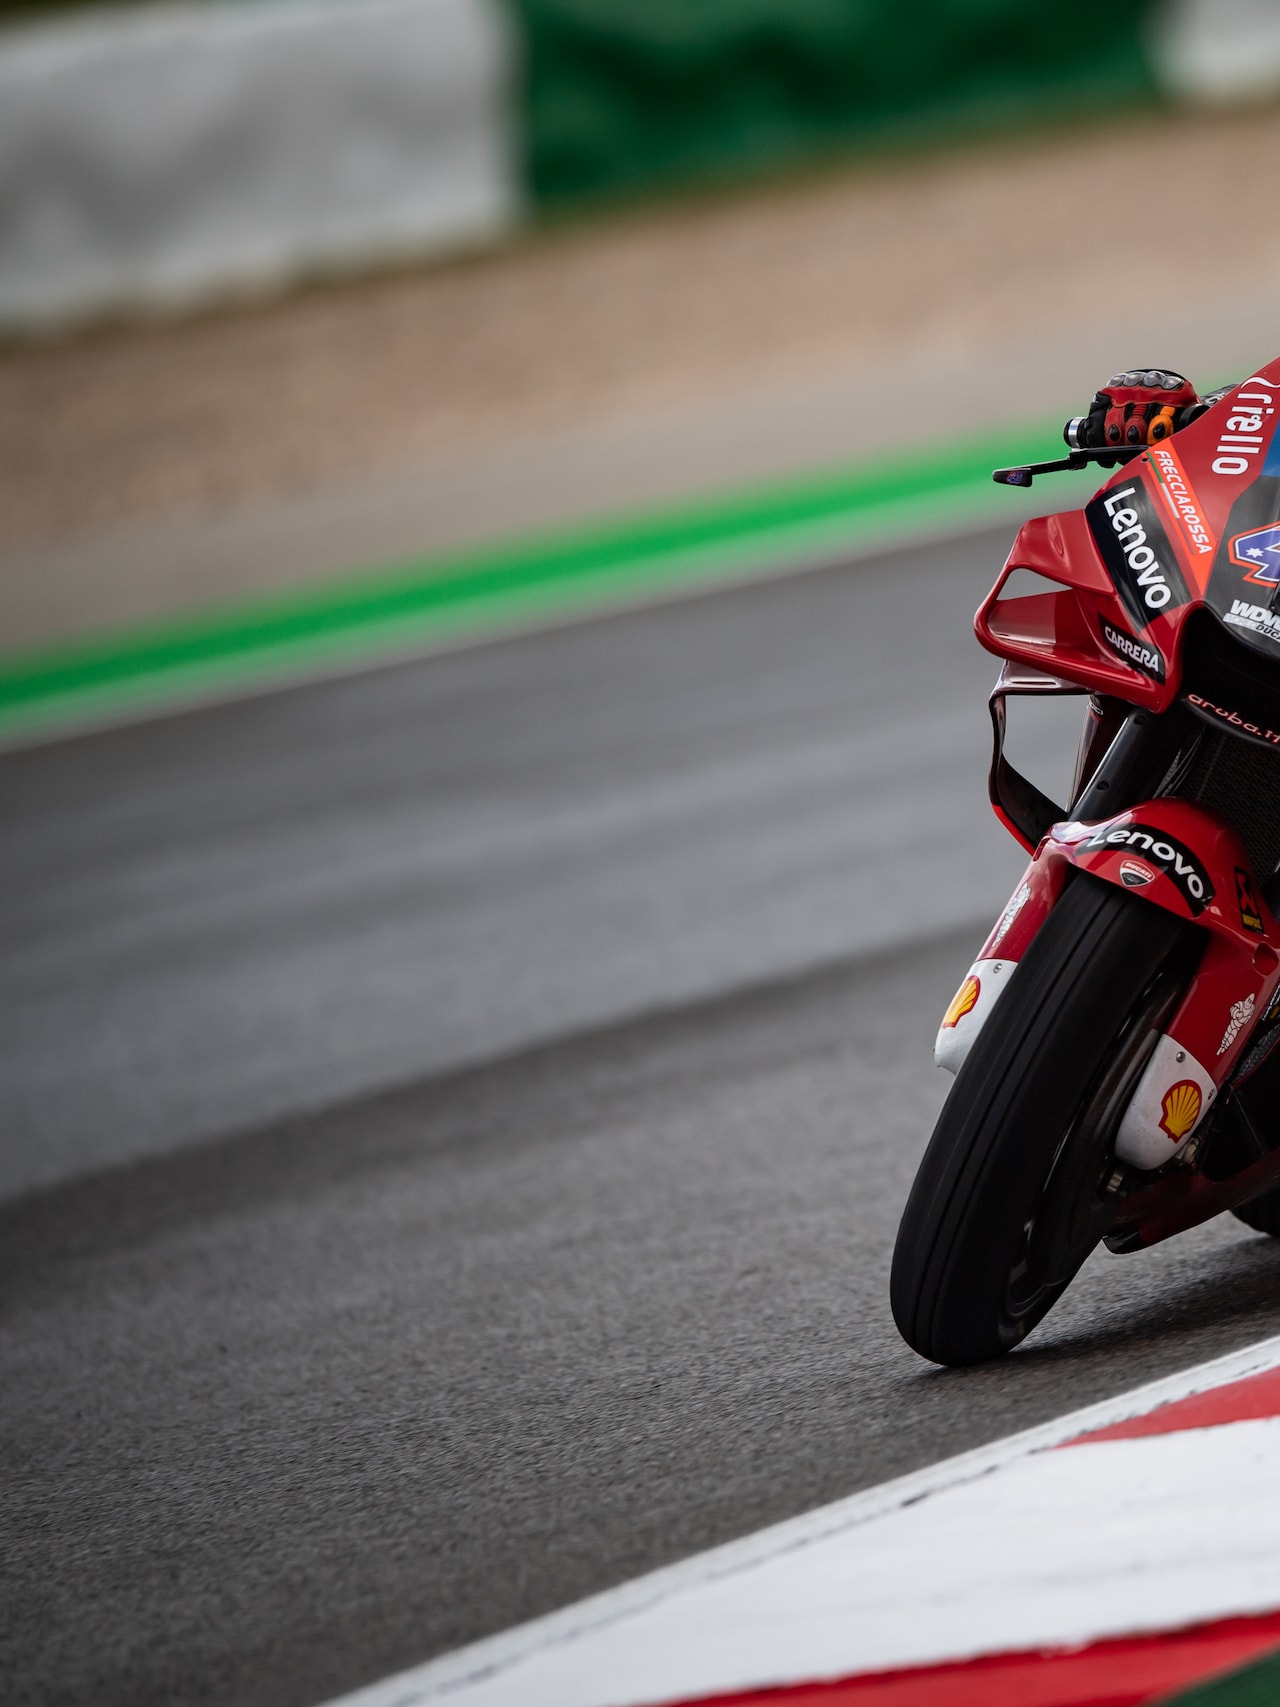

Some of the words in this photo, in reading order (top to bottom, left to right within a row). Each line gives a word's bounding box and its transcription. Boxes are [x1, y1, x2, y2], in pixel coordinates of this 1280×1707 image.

[1154, 449, 1213, 555] FRECCIAROSSA
[1103, 487, 1172, 610] Lenovo
[1104, 626, 1159, 672] CARRERA
[1086, 829, 1205, 899] Lenovo
[1124, 861, 1153, 879] DUCATI
